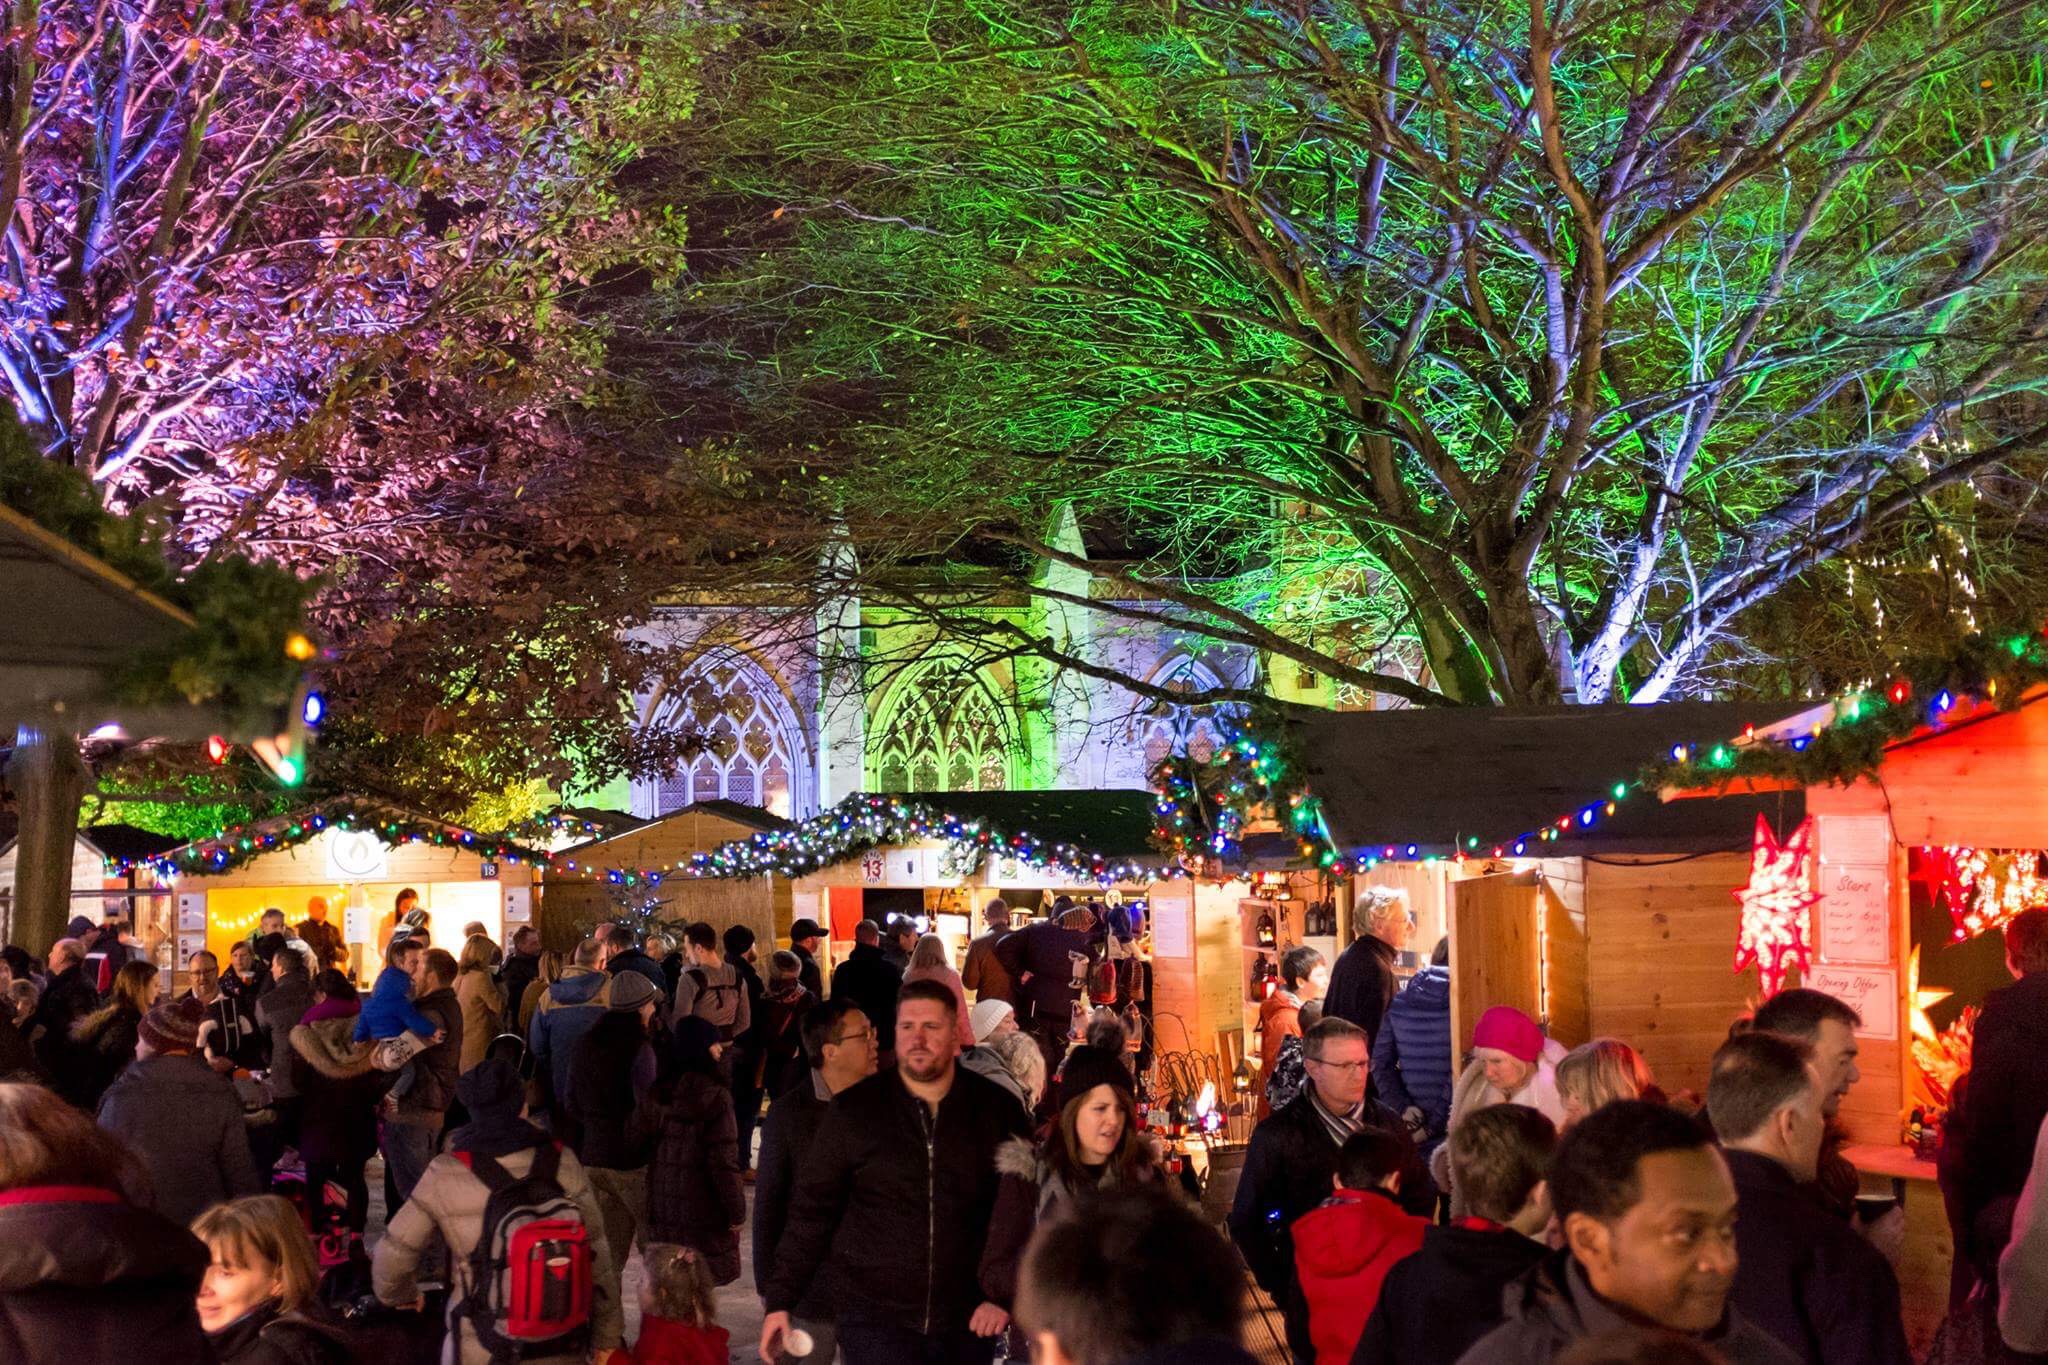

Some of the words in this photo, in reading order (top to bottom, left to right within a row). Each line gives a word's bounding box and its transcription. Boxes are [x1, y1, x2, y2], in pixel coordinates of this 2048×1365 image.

[484, 865, 496, 876] 18
[863, 860, 881, 877] 13
[1837, 875, 1872, 892] Stars
[1853, 975, 1878, 992] Offer
